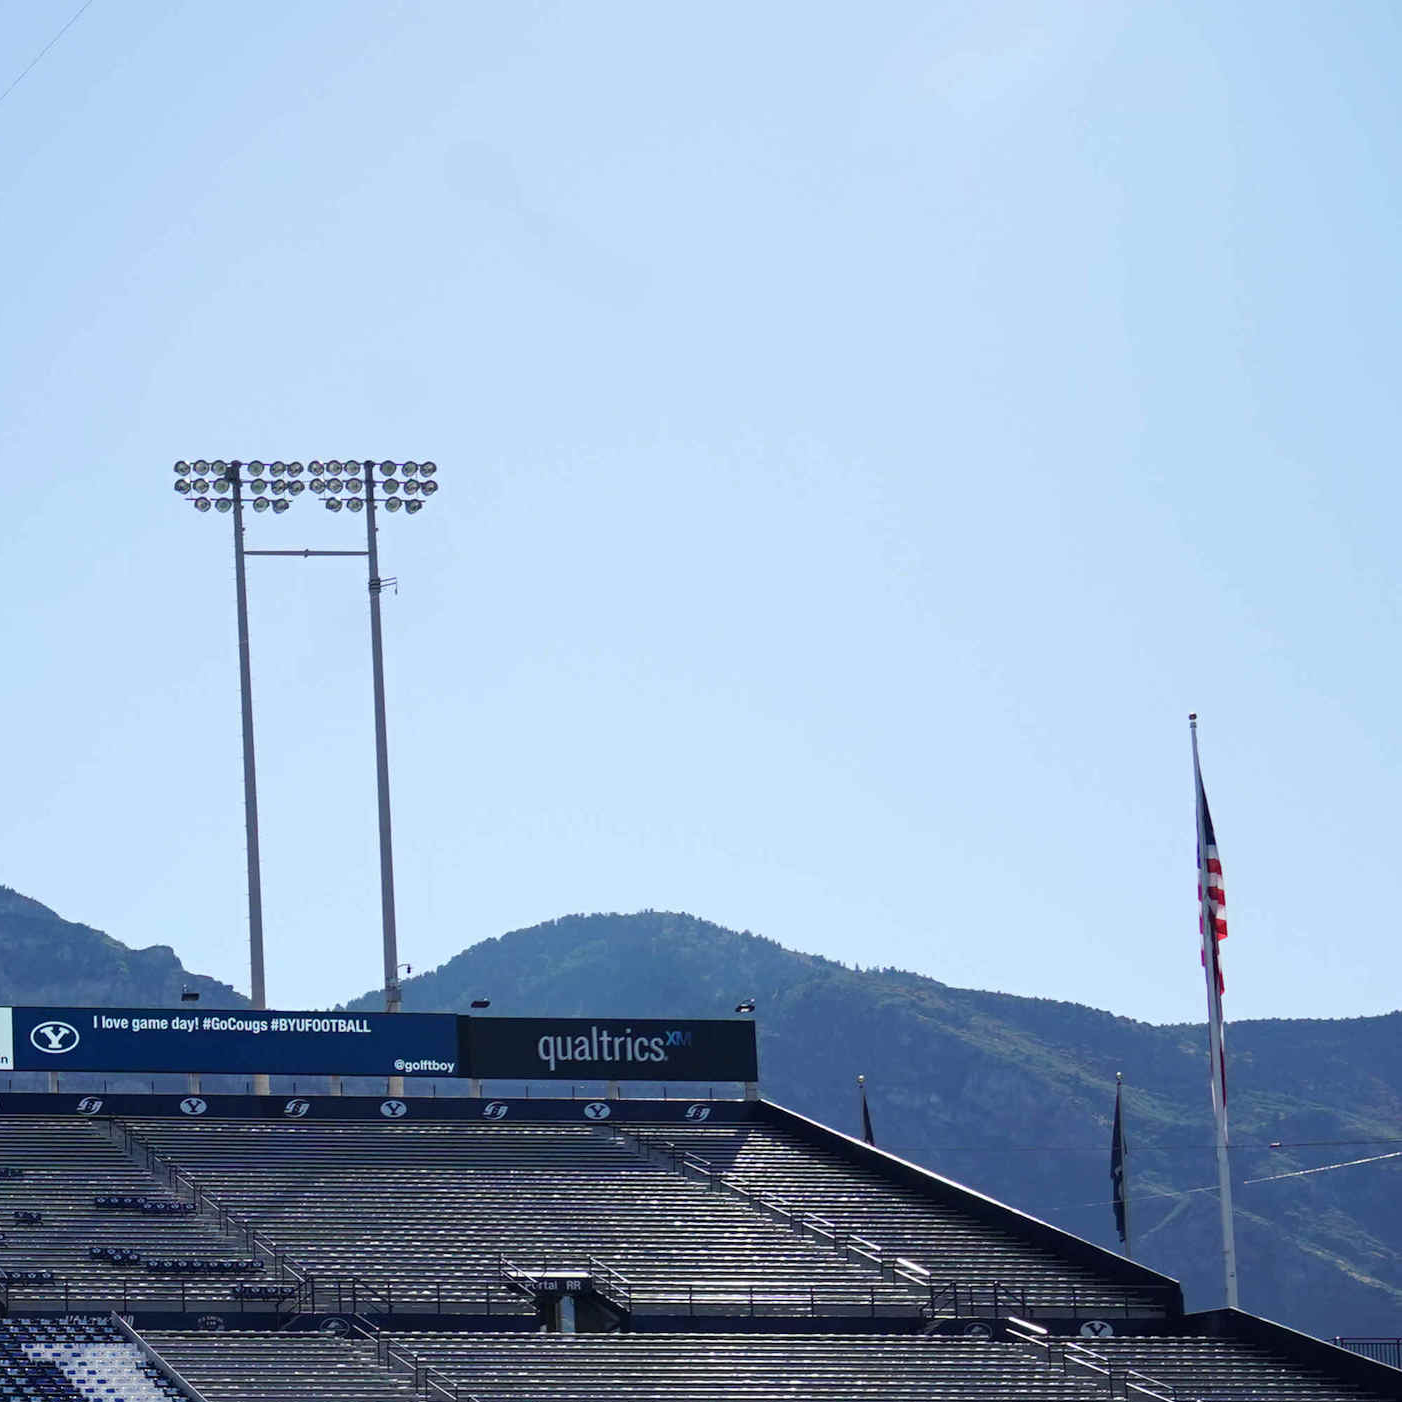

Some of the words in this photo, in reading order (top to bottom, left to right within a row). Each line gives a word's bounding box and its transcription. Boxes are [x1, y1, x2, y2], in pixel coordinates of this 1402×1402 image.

[101, 1016, 128, 1029] love
[132, 1018, 168, 1032] game
[171, 1018, 199, 1031] day!
[202, 1018, 269, 1033] #GoCougs
[270, 1019, 371, 1033] #BYUFOOTBALL
[666, 1031, 692, 1047] XM
[538, 1026, 665, 1071] qualtrics
[394, 1059, 455, 1074] @golftboy
[566, 1280, 581, 1290] RR
